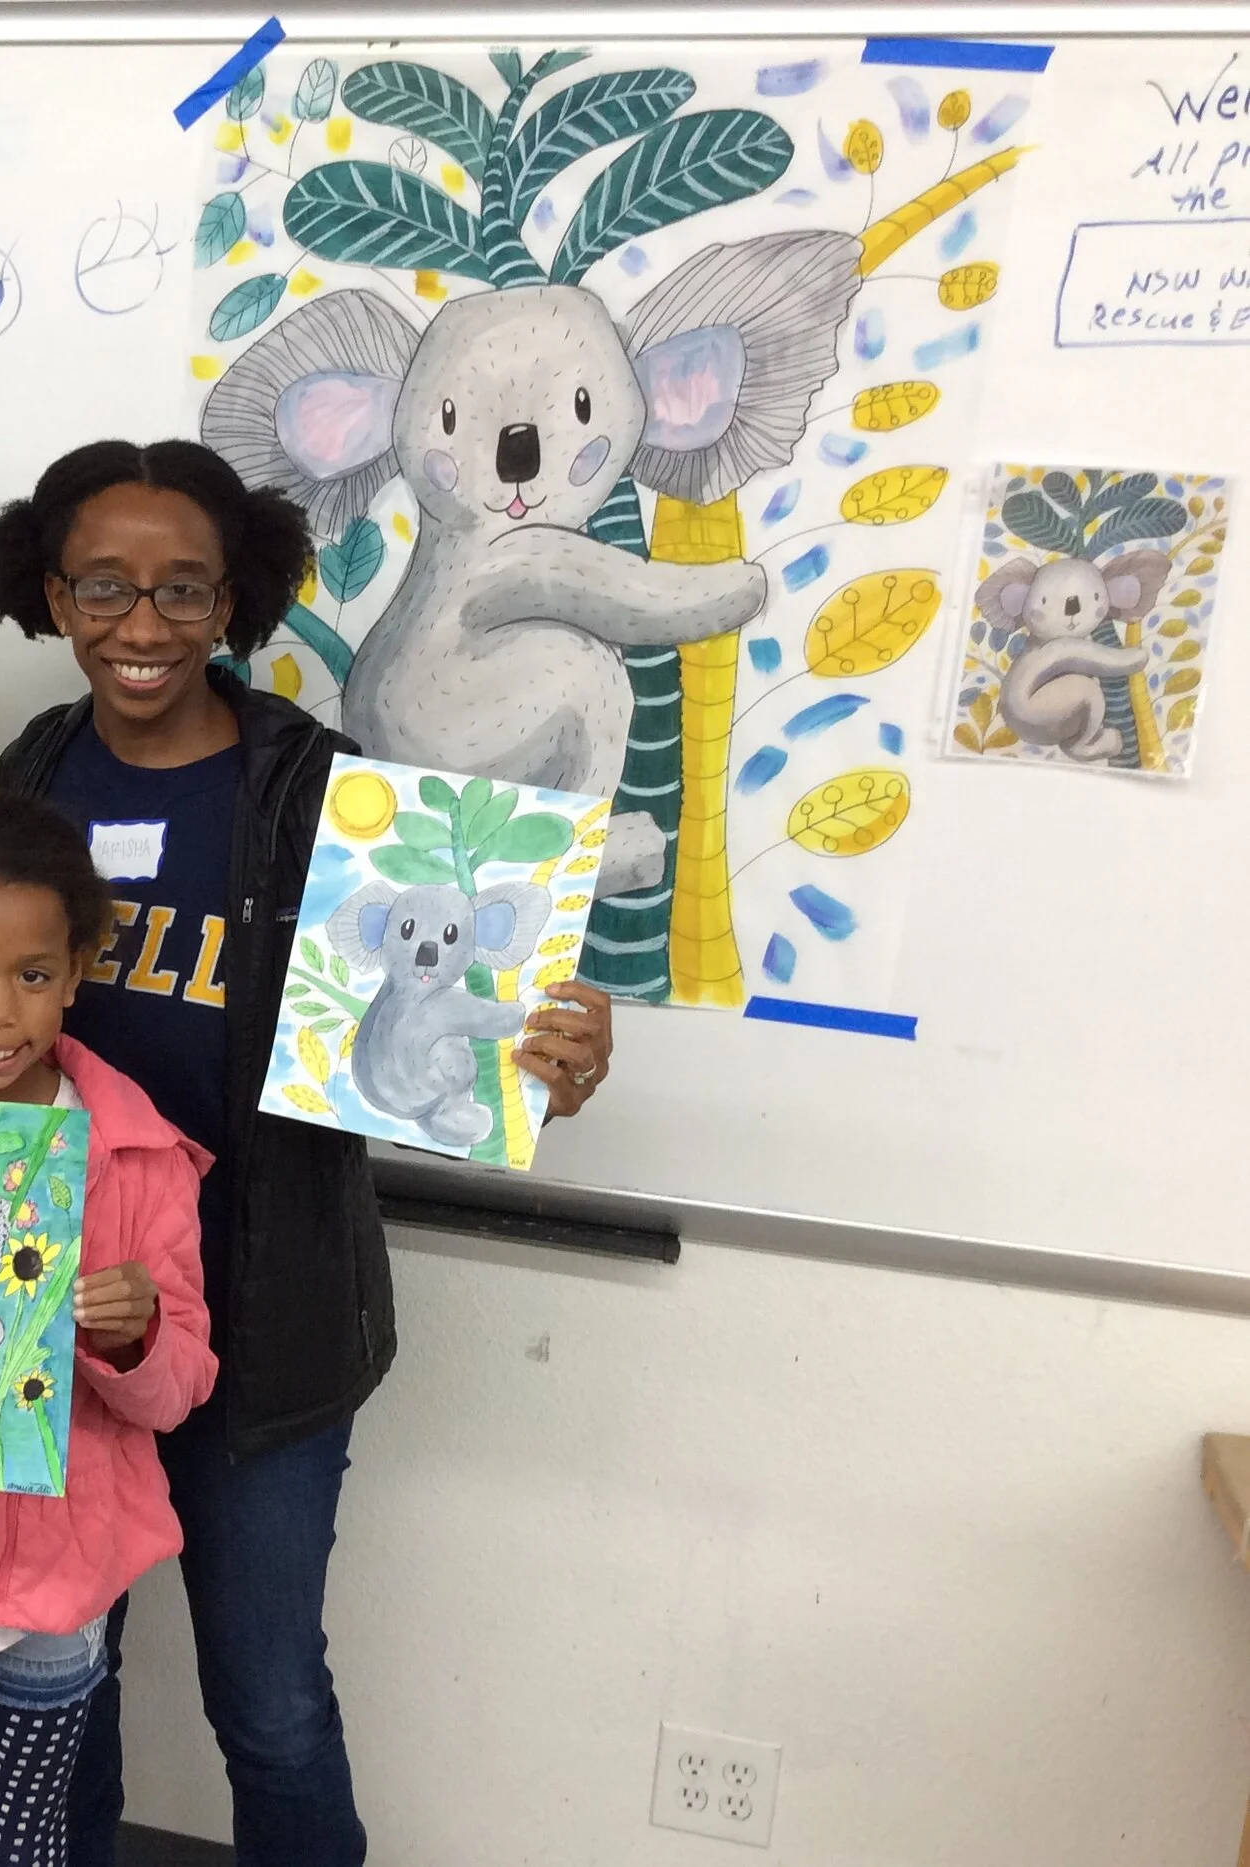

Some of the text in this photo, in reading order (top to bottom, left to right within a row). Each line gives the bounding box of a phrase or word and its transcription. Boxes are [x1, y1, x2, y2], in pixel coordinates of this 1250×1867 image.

[1171, 185, 1231, 213] the
[1125, 268, 1200, 298] NSW
[1089, 303, 1194, 332] Rescue
